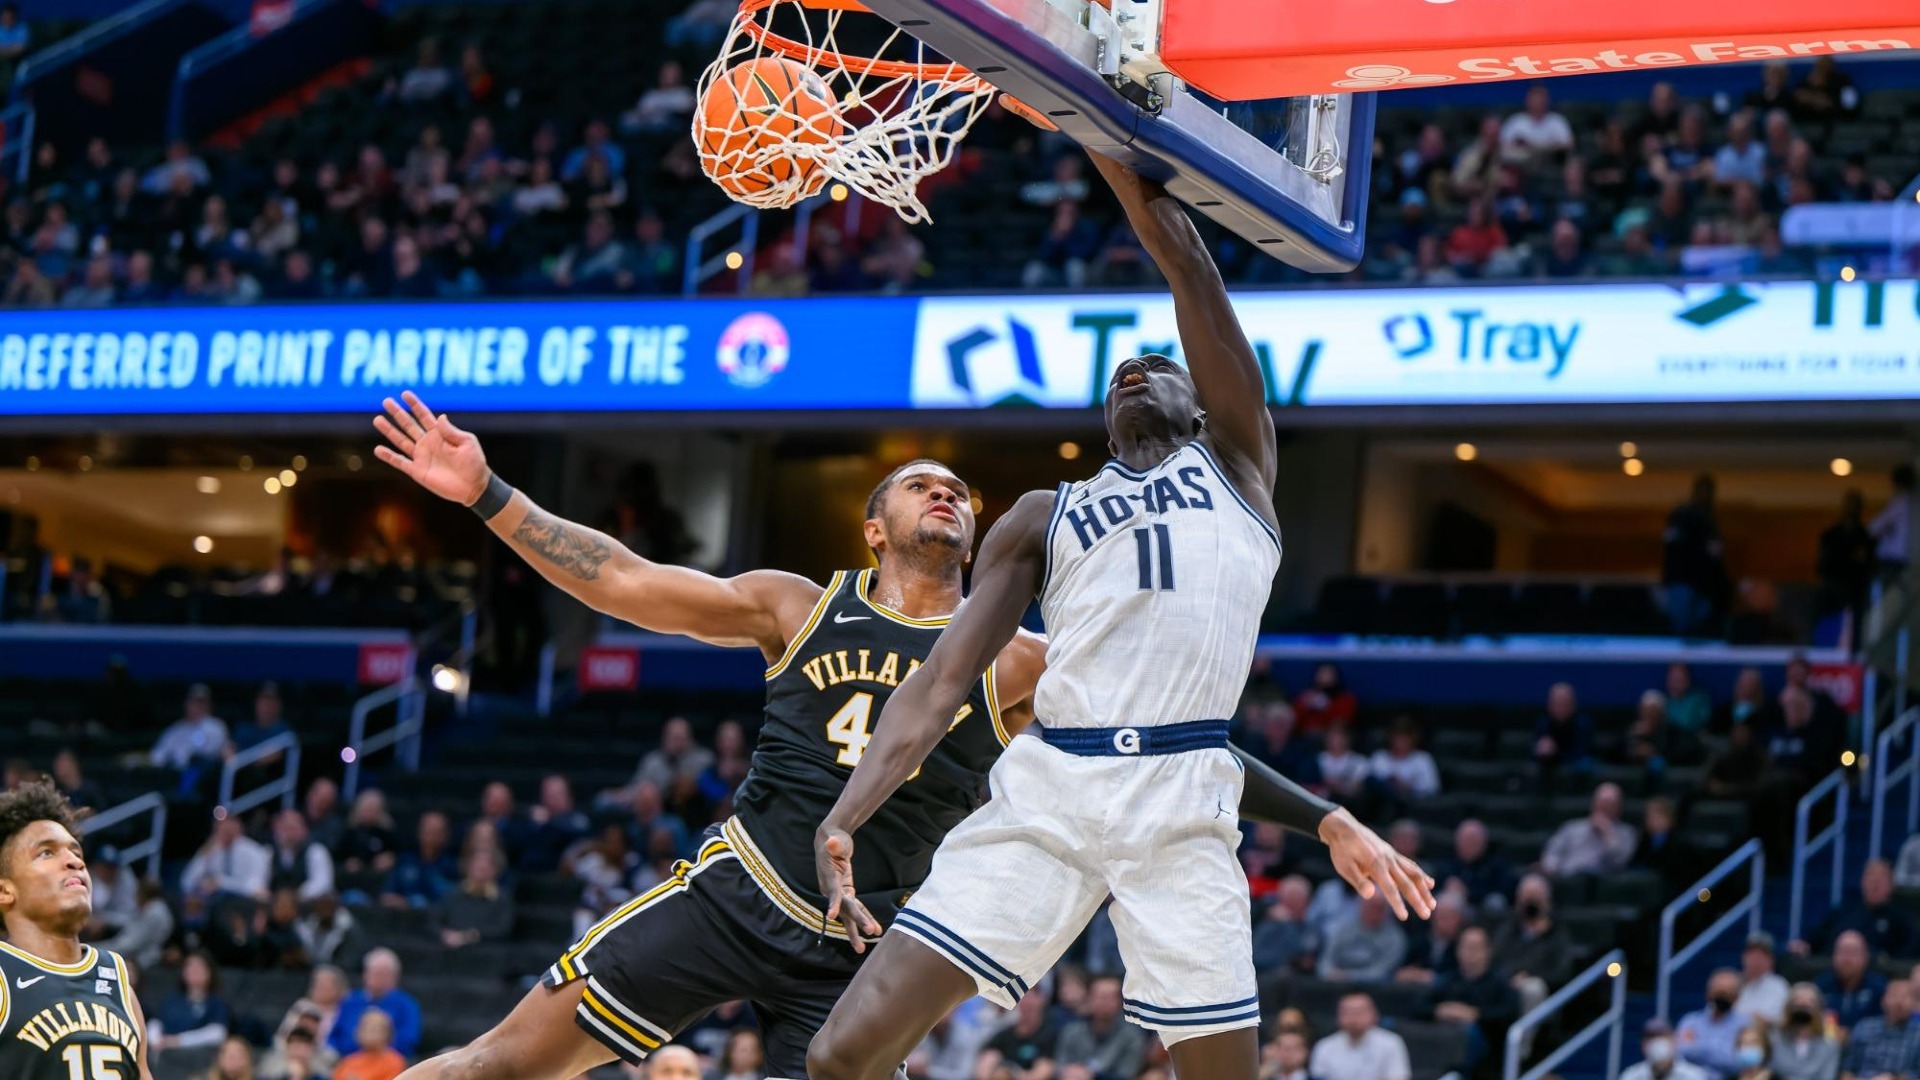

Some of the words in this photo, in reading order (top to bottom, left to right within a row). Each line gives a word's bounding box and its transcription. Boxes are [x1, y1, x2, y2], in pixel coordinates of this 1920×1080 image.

[1458, 49, 1686, 79] State
[1690, 39, 1911, 62] Farm
[0, 331, 199, 390] REFERRED
[207, 329, 333, 387] PRINT
[341, 327, 529, 386] PARTNER
[538, 326, 596, 386] OF
[608, 324, 689, 385] THE
[1450, 309, 1580, 379] Tray
[1066, 467, 1214, 551] HOYAS
[1133, 523, 1176, 591] 11
[1113, 728, 1140, 754] G
[16, 1001, 138, 1062] VILLANOVA
[62, 1044, 122, 1080] 15
